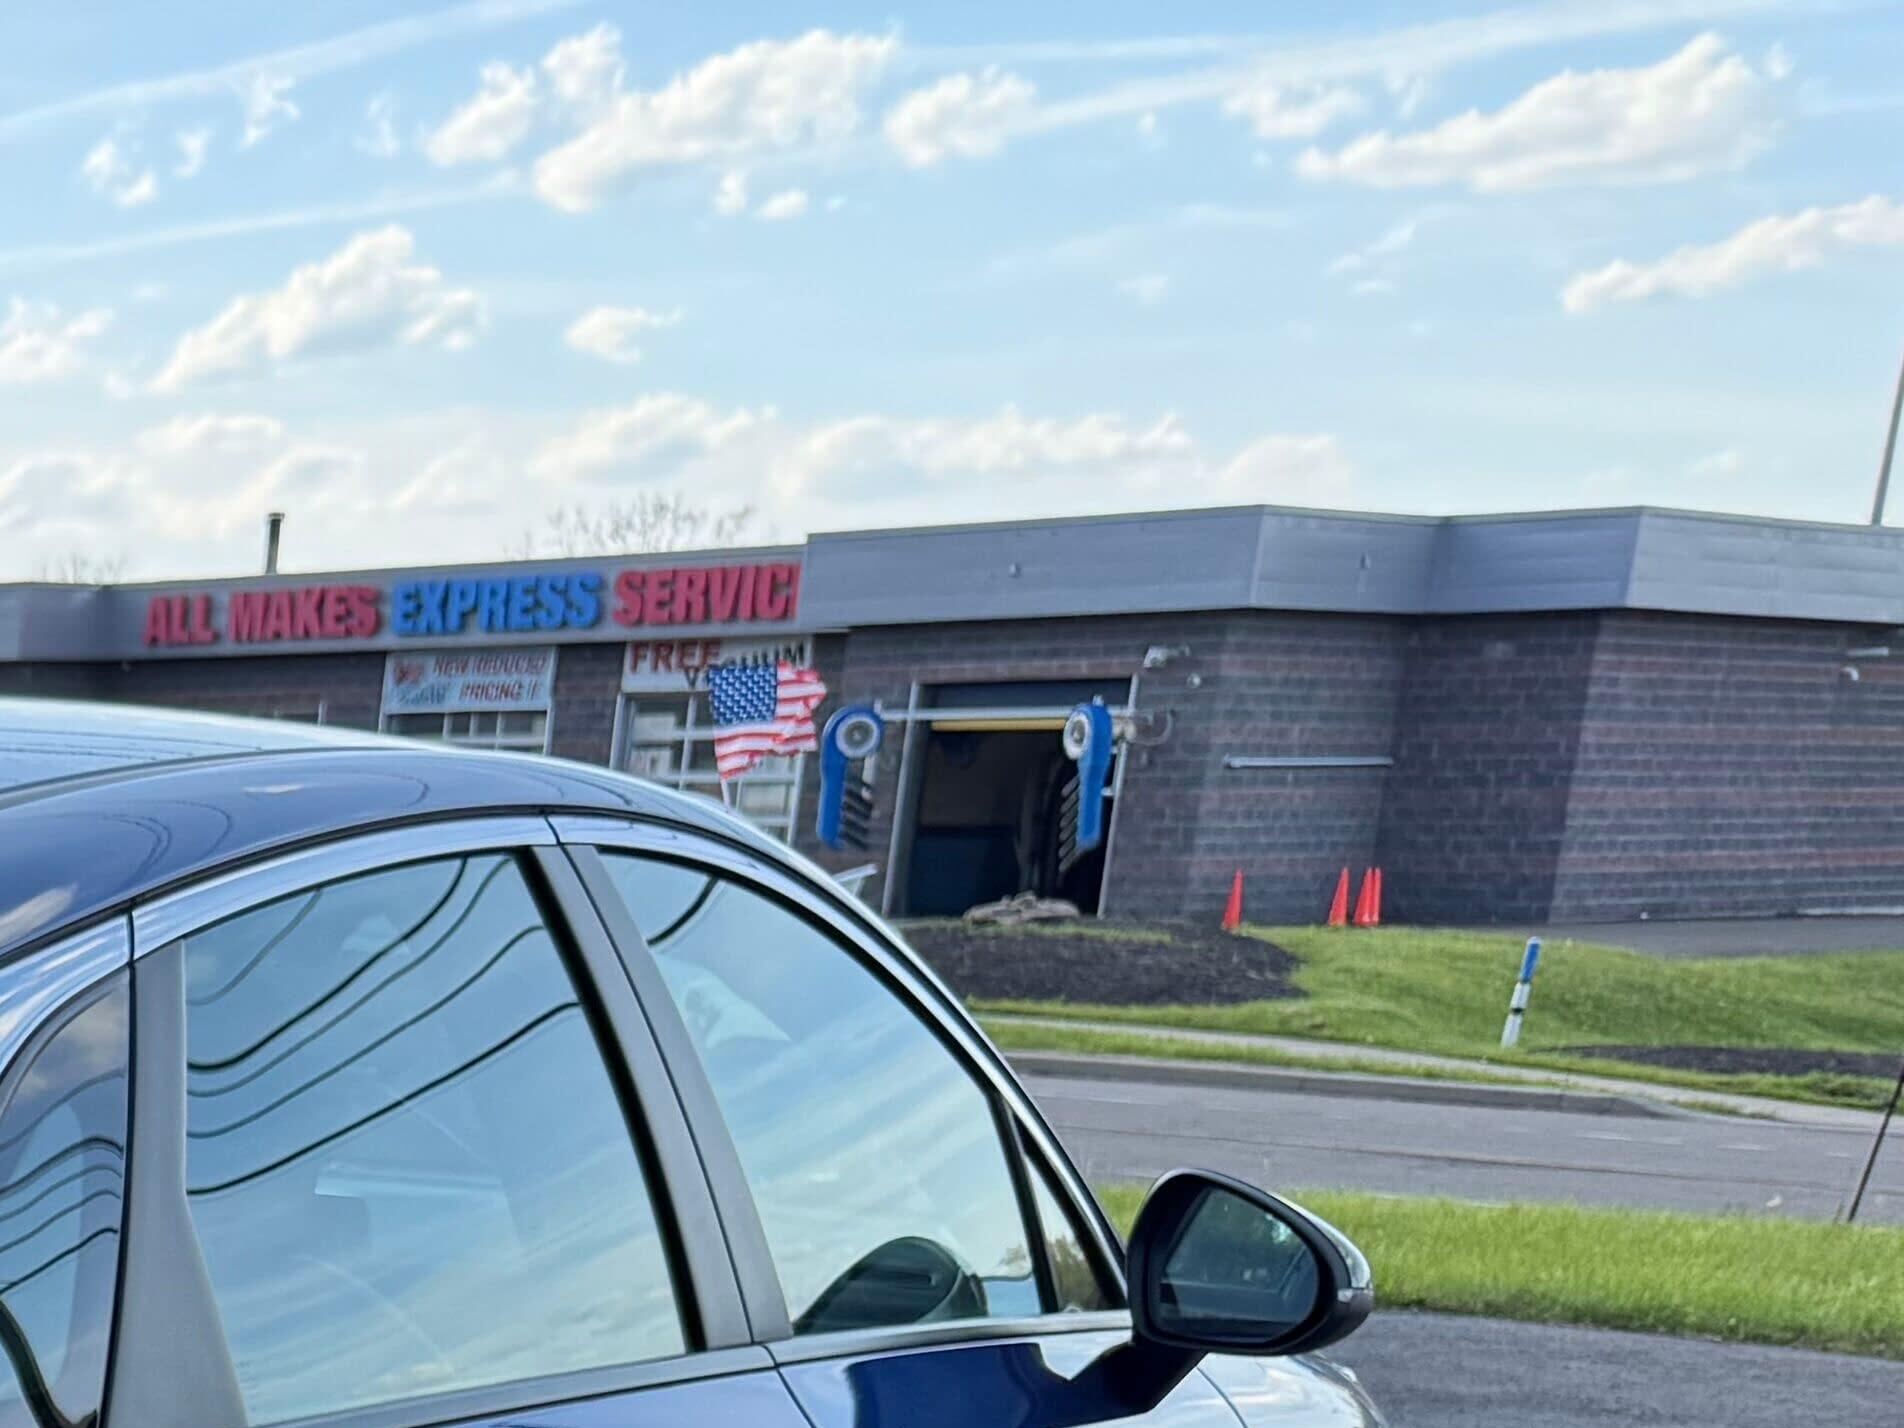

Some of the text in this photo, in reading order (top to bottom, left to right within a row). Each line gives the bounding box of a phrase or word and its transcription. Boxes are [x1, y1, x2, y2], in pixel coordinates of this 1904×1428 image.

[145, 595, 217, 646] ALL
[228, 584, 382, 642] MAKES
[394, 572, 603, 637] EXPRESS
[630, 639, 722, 673] FREE
[459, 681, 524, 701] PRICING
